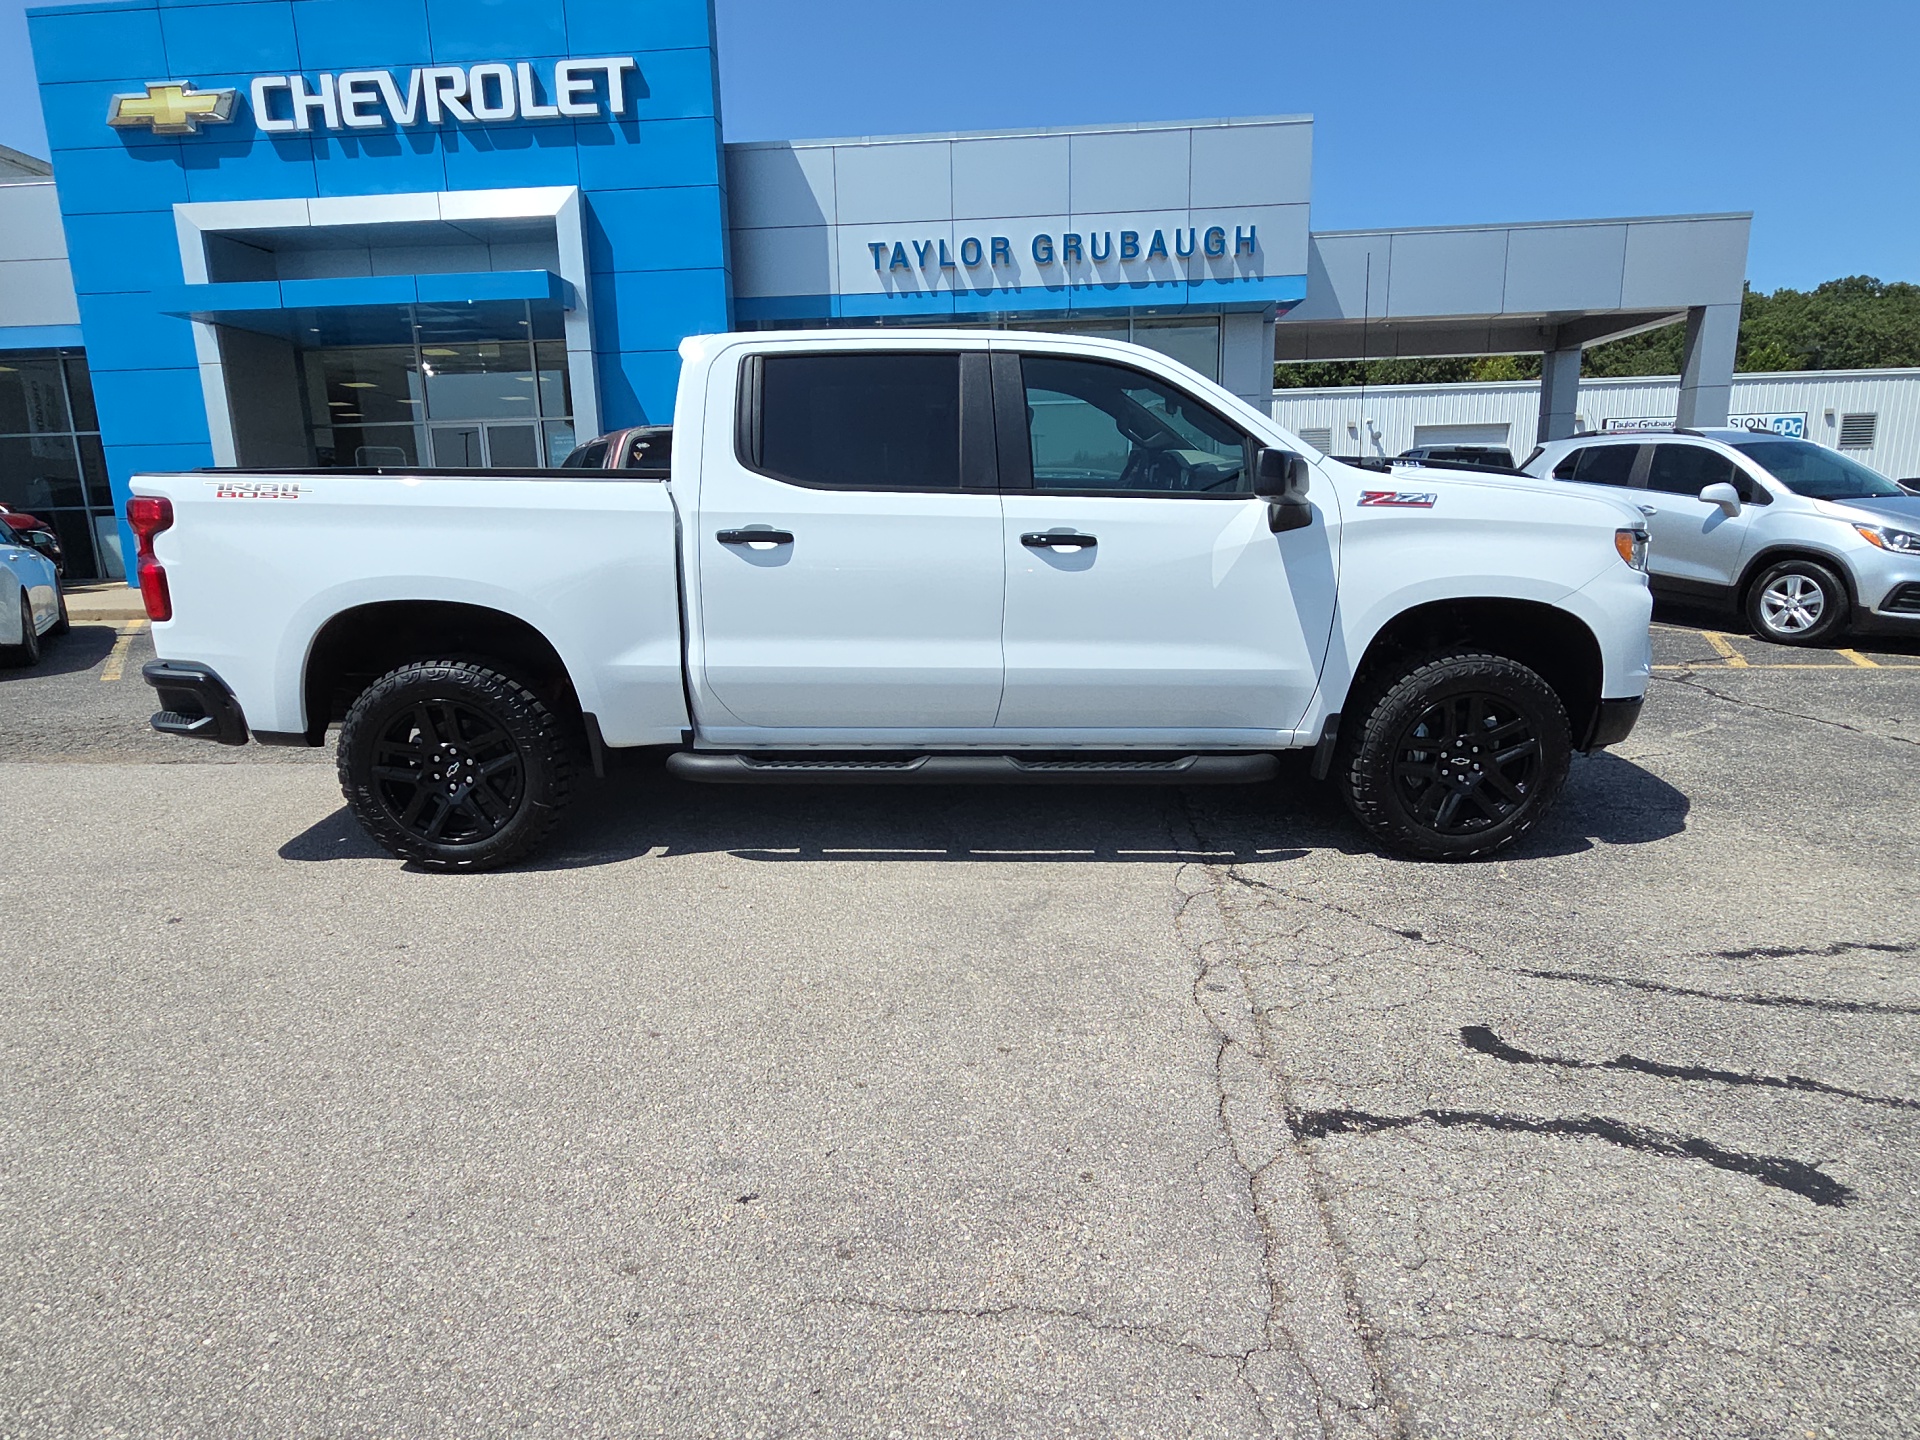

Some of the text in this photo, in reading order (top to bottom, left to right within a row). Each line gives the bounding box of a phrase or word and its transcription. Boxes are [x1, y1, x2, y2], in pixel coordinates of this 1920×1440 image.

[250, 56, 636, 132] CHEVROLET
[868, 225, 1257, 271] TAYLOR GRUBAUGH
[1610, 417, 1768, 429] Taylor Grubaug SION
[204, 482, 313, 492] TRAIL
[216, 491, 299, 499] BOSS
[1356, 490, 1438, 508] Z71
